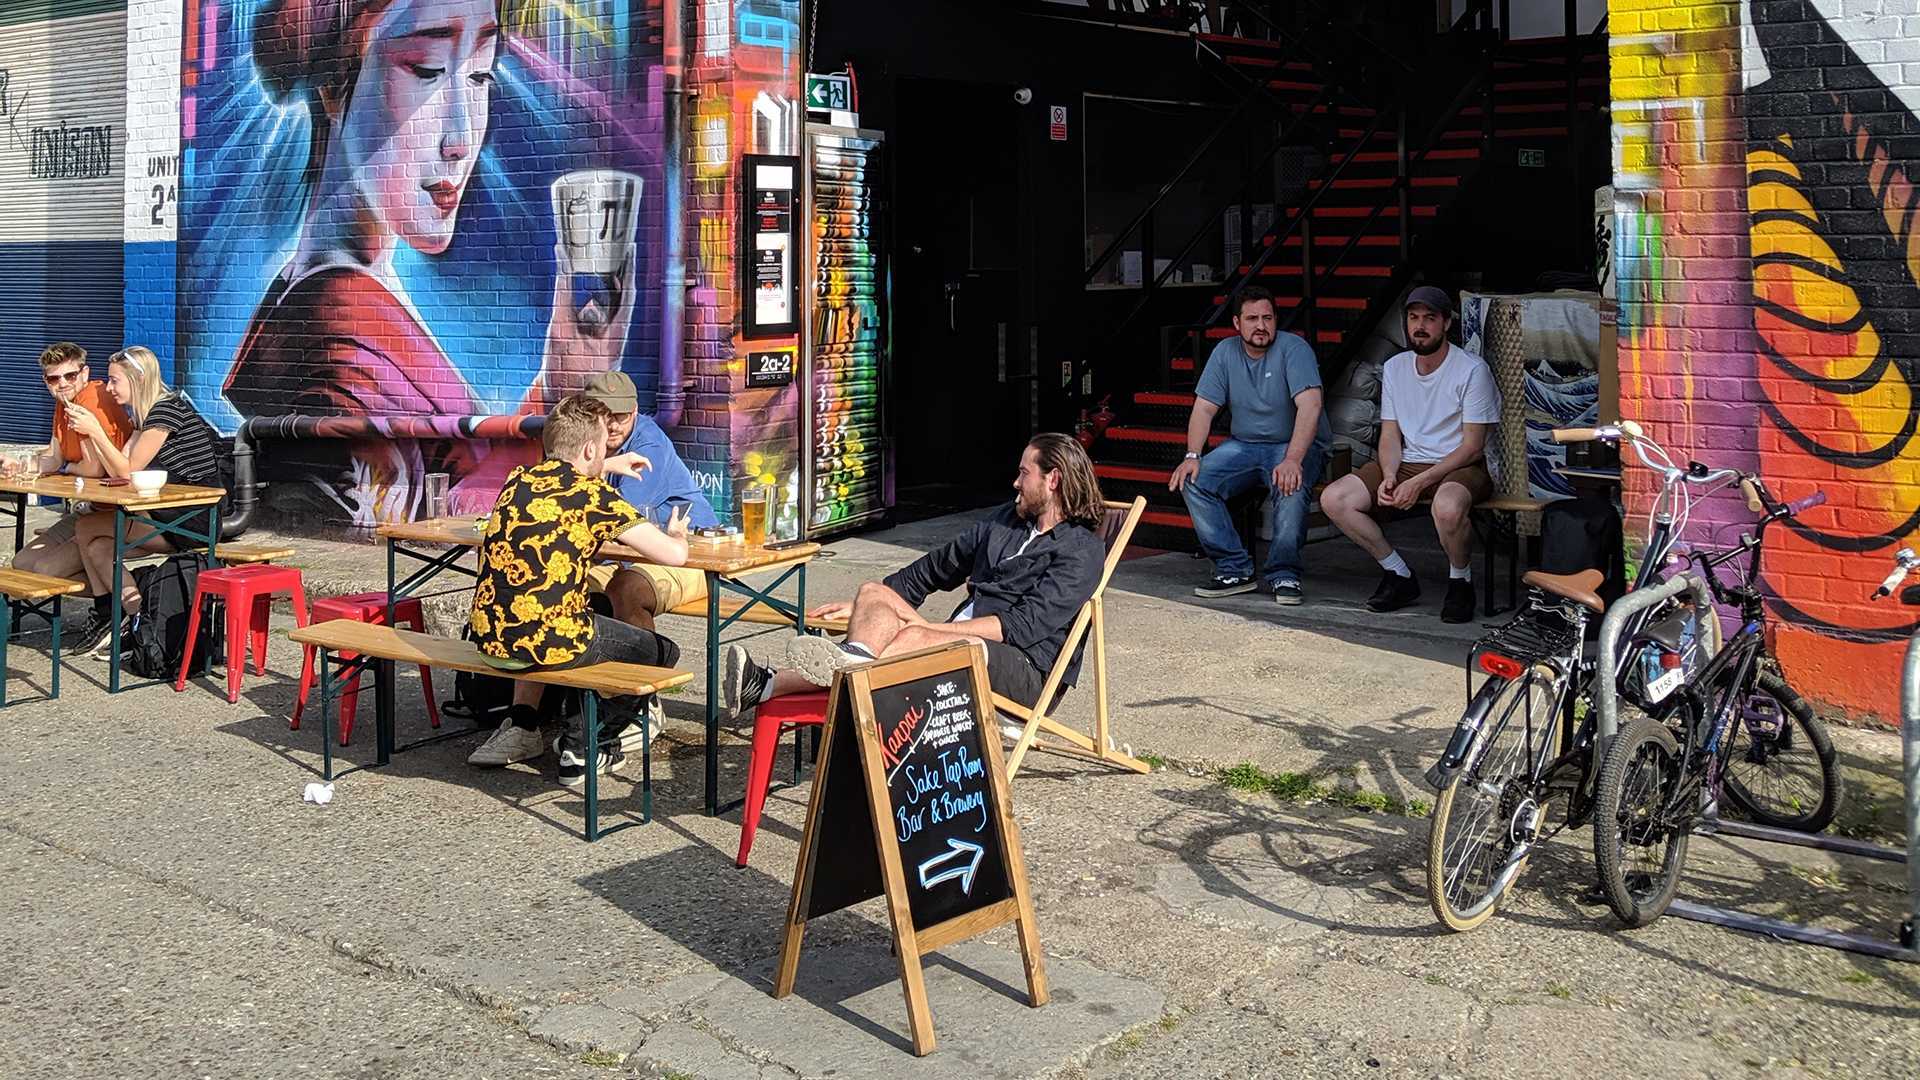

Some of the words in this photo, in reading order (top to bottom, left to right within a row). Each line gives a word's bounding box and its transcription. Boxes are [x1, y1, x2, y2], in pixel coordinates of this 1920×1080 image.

[148, 156, 179, 177] UNIT
[760, 354, 791, 372] 2a-2
[691, 469, 724, 498] DON
[876, 697, 924, 769] Kanpai
[905, 764, 943, 804] Sake
[938, 751, 962, 791] Tap
[897, 805, 926, 842] Bar
[931, 798, 943, 824] &
[941, 791, 987, 832] Brewery
